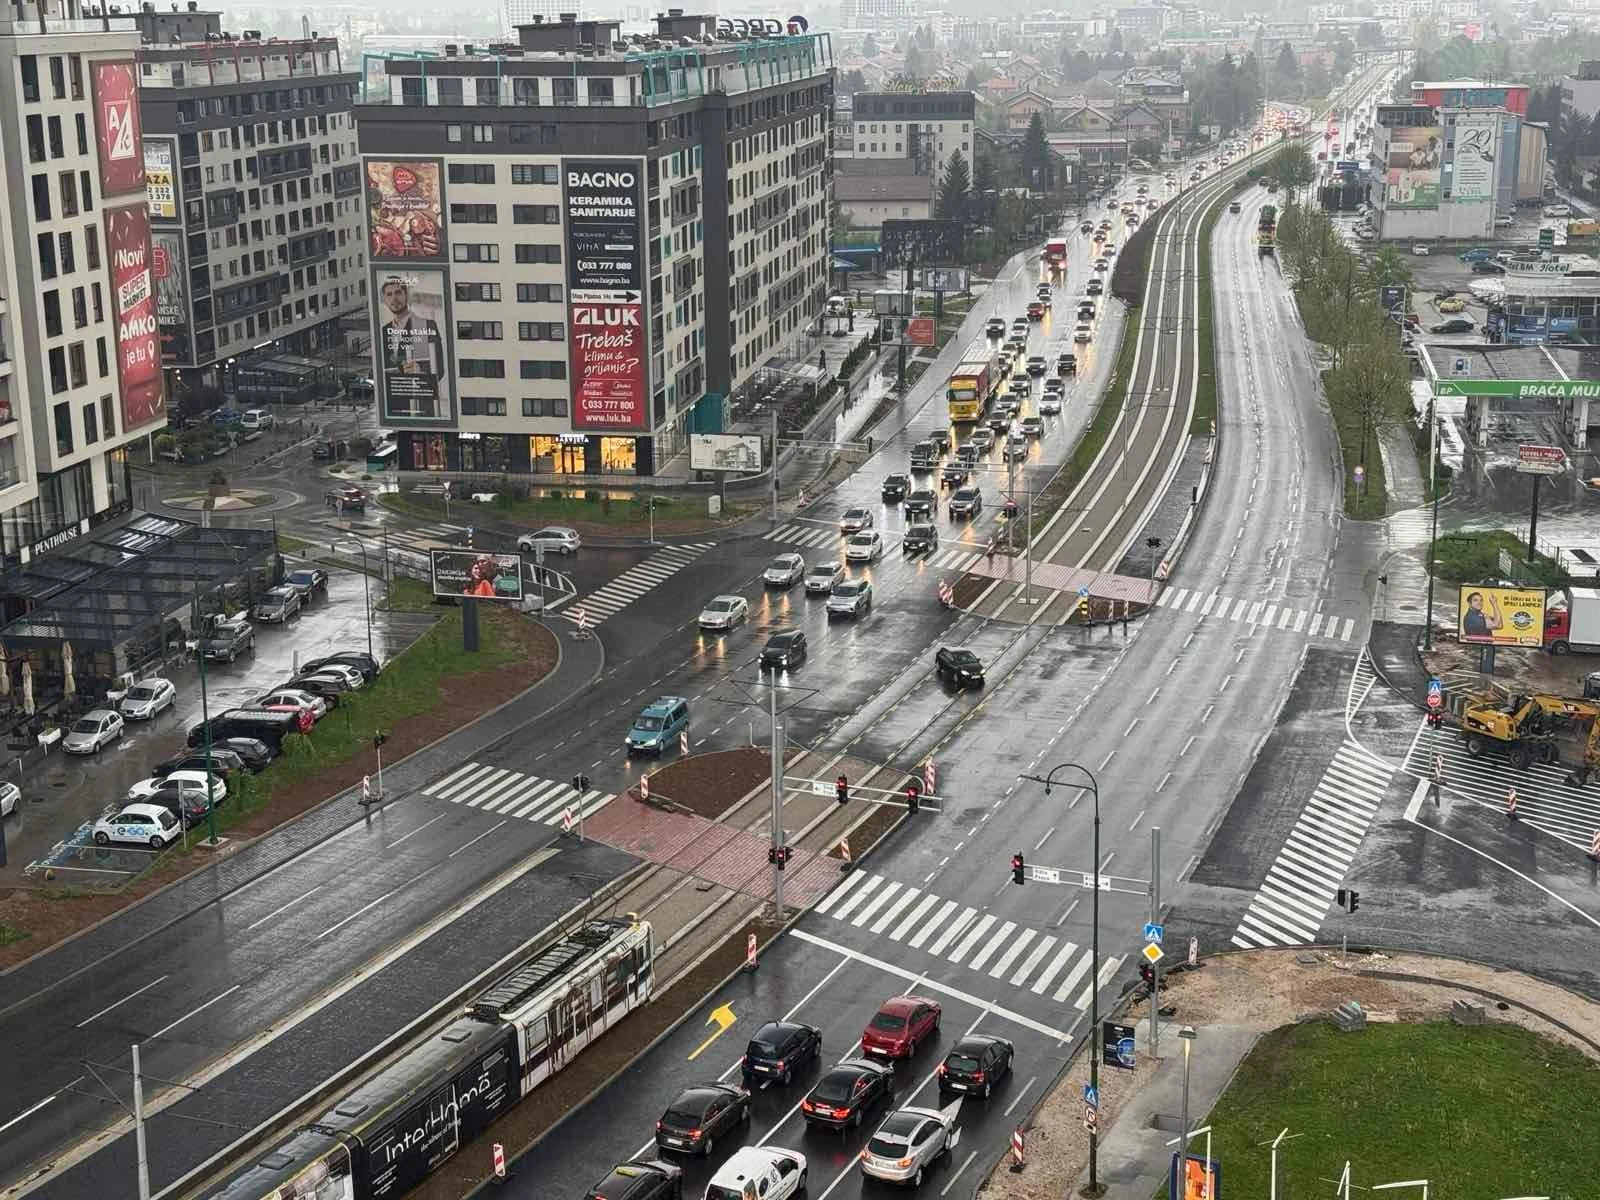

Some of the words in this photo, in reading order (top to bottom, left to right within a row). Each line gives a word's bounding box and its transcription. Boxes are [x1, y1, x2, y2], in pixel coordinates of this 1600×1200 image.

[568, 172, 634, 188] BAGNO
[570, 196, 632, 206] KERAMIKA
[570, 208, 635, 217] SANITARIJE
[119, 246, 143, 270] Novi
[122, 275, 145, 299] SUPER
[591, 308, 640, 326] LUK
[120, 314, 156, 342] AMKO
[576, 329, 633, 349] Trebaš
[126, 349, 136, 369] je
[136, 347, 146, 361] tu
[584, 351, 613, 363] klimu
[584, 358, 639, 377] grijanje?
[1520, 383, 1565, 396] BRAĆA
[588, 400, 602, 409] 033
[605, 401, 618, 409] 777
[586, 414, 631, 423] www.luk.ba
[34, 526, 78, 555] PENTHOUSE
